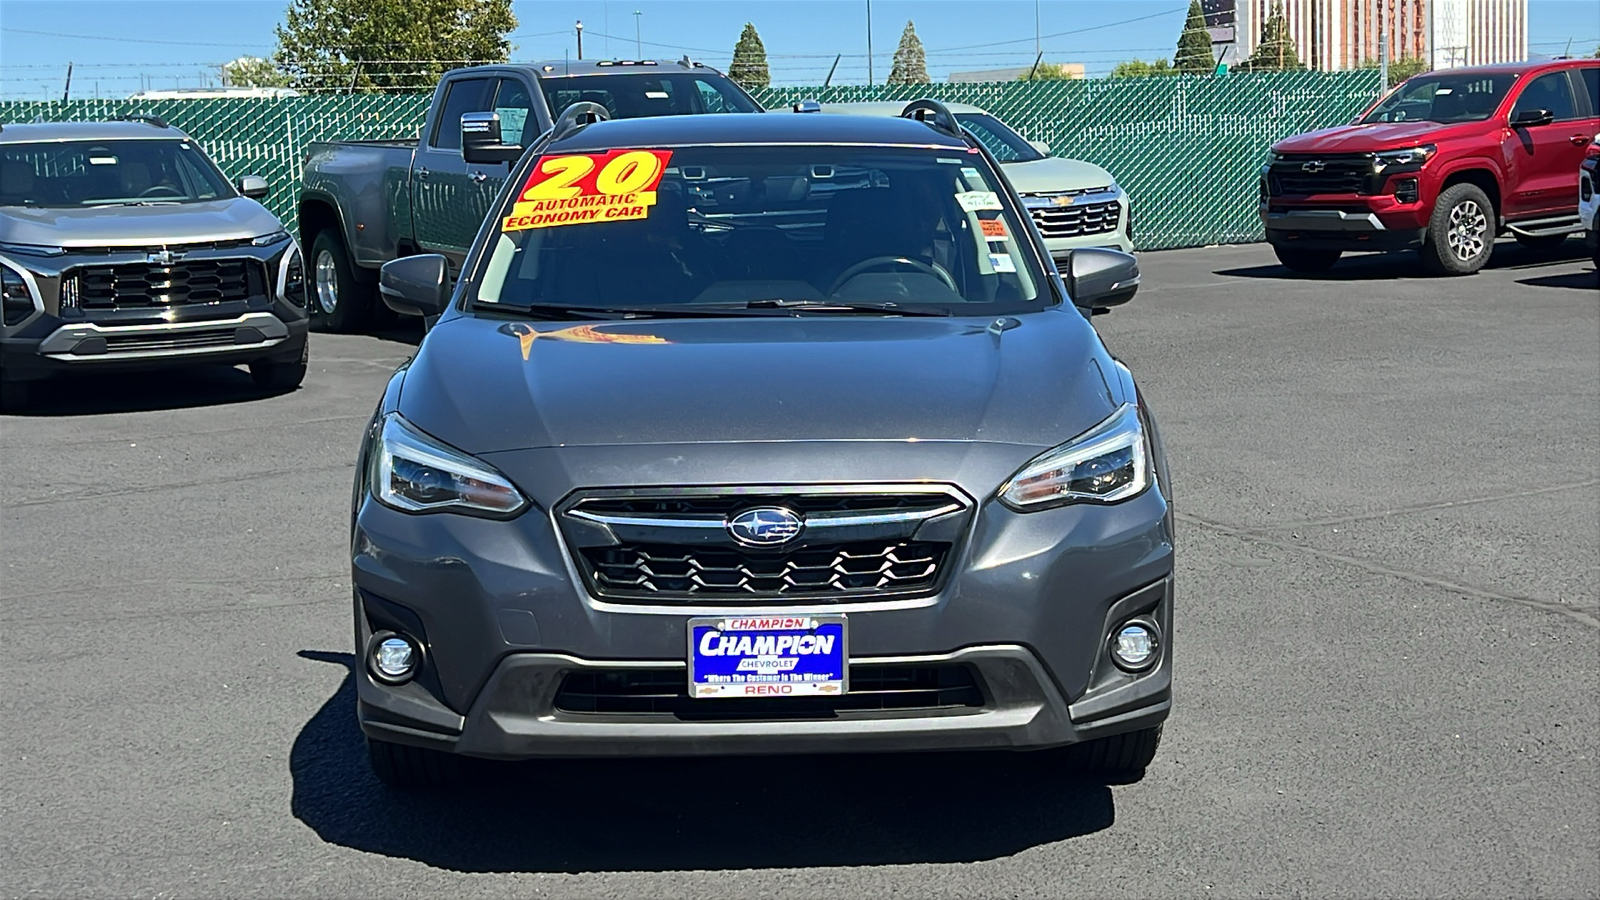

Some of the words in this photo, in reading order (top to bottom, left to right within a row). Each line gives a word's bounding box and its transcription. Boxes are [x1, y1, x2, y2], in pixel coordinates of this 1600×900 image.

[523, 151, 662, 201] 20
[532, 193, 638, 212] AUTOMATIC
[505, 209, 600, 228] ECONOMY
[605, 206, 644, 218] CAR
[731, 618, 804, 630] CHAMPION
[699, 631, 835, 656] CHAMPION
[741, 660, 793, 668] CHEVROLET
[732, 674, 745, 682] The
[747, 673, 780, 682] Customer
[790, 673, 802, 682] The
[745, 685, 792, 695] RENO
